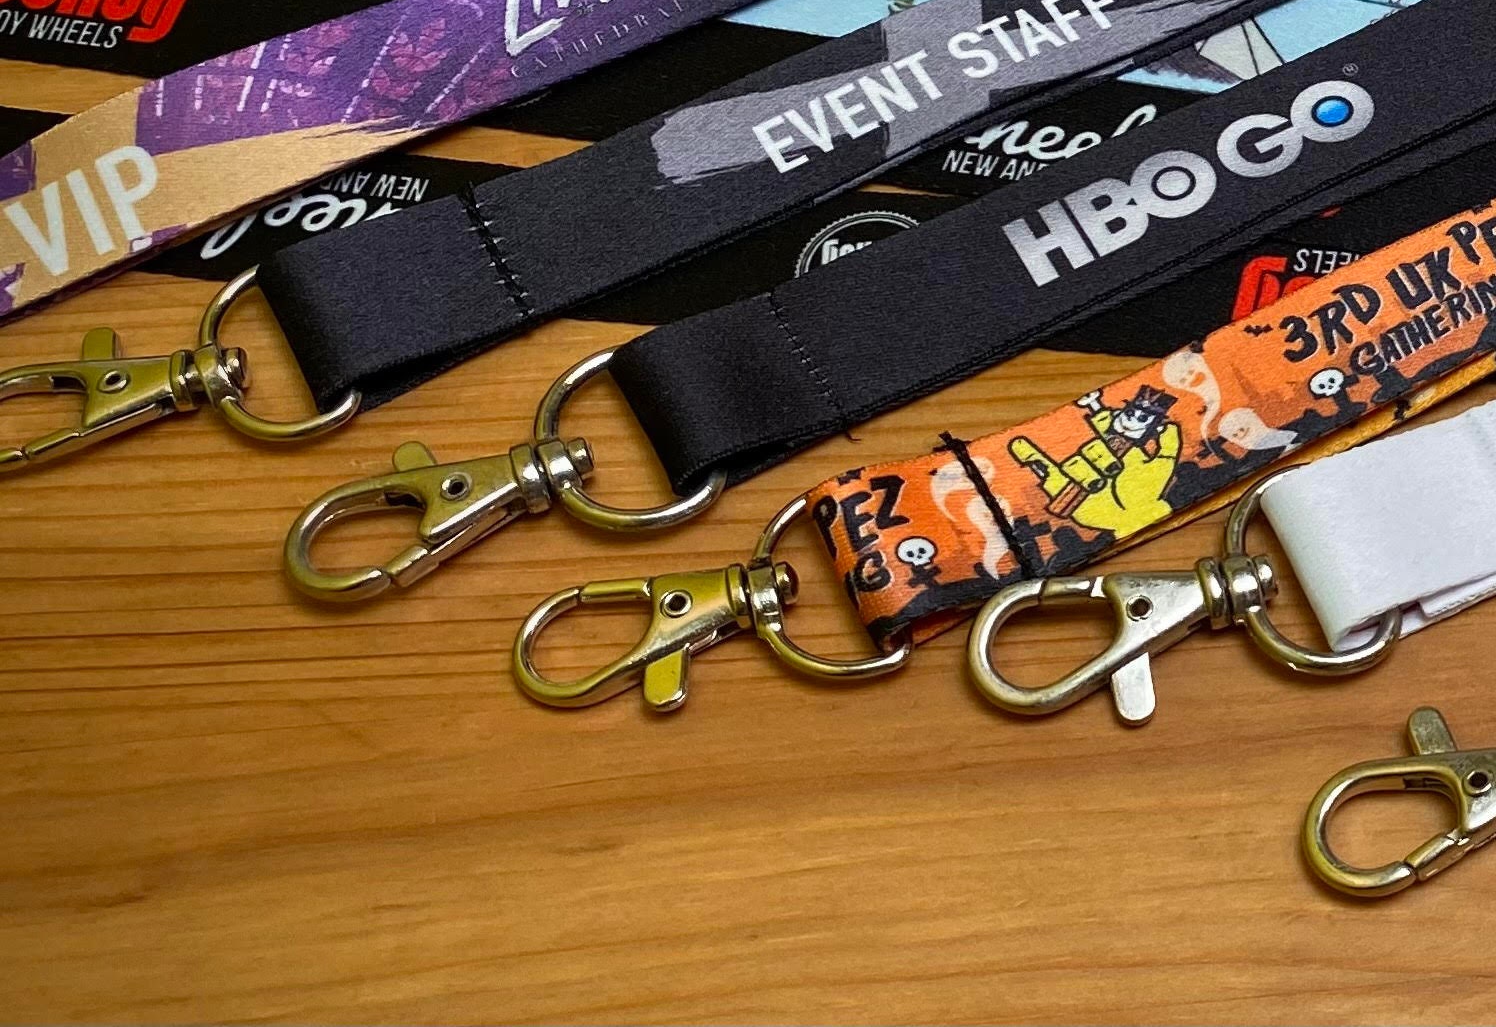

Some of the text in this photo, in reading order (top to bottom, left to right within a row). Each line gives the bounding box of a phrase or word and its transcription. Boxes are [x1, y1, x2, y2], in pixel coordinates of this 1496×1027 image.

[28, 13, 124, 49] WHEELS
[751, 52, 947, 175] EVENT
[941, 149, 1001, 178] NEW
[3, 144, 160, 278] VIP
[371, 174, 430, 202] NEW
[1002, 79, 1377, 288] HBO GO
[1278, 284, 1383, 364] 3RD
[1385, 247, 1465, 311] UK
[811, 474, 911, 560] PEZ
